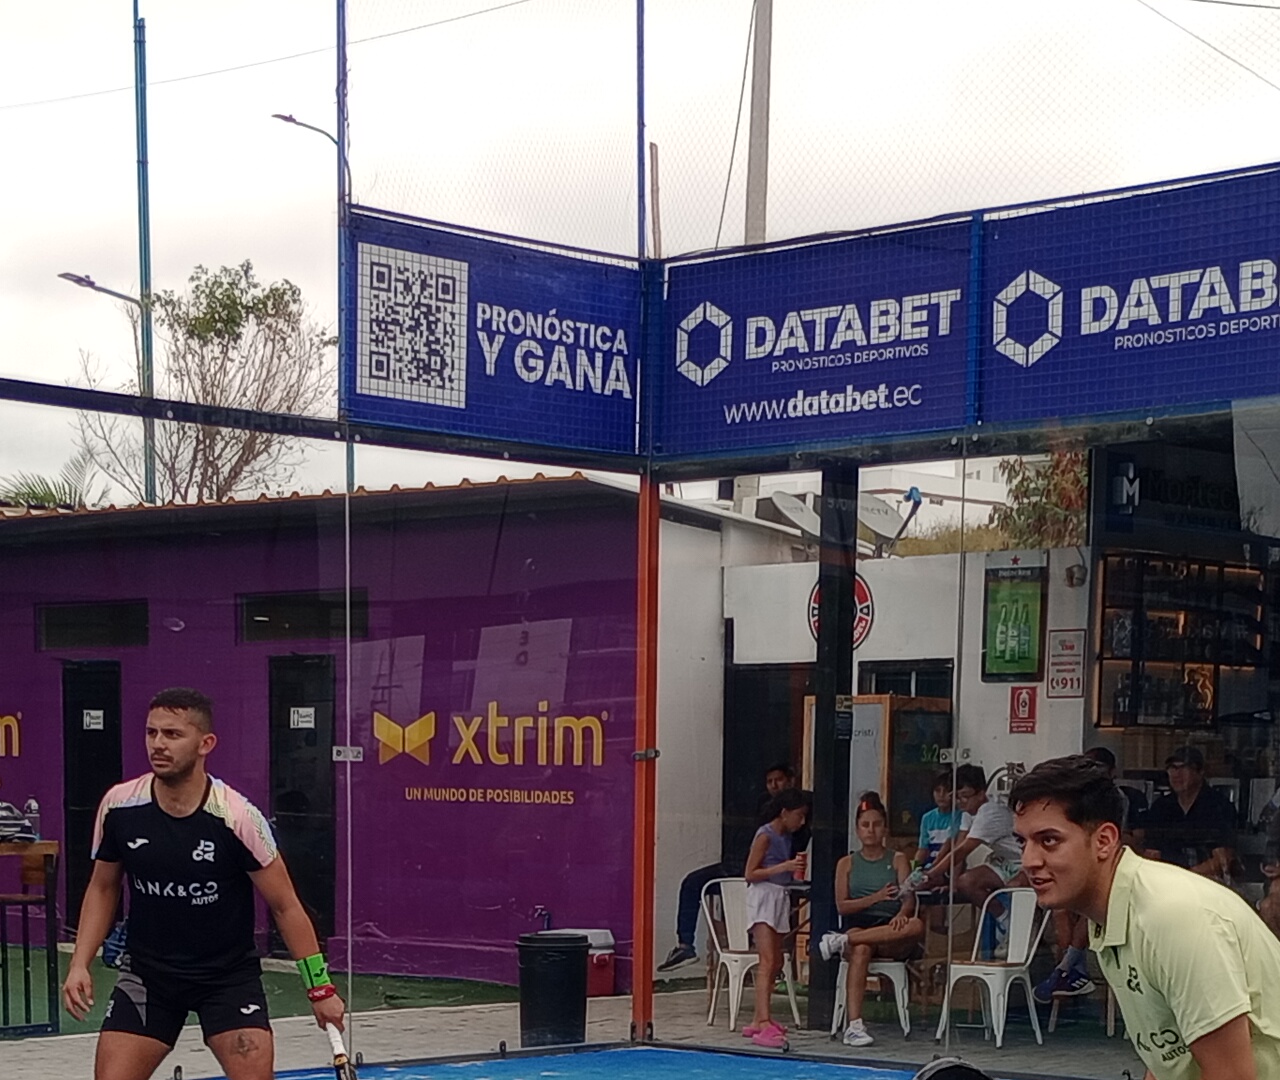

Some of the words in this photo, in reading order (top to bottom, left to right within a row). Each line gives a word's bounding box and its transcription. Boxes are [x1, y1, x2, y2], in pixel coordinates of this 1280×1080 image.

[476, 302, 629, 355] PRONÓSTICA
[745, 288, 960, 361] DATABET
[1114, 322, 1216, 351] PRONOSTICOS
[477, 332, 506, 377] Y
[513, 338, 632, 400] GANA
[771, 353, 852, 374] PRONOSTICOS
[853, 343, 929, 365] DEPORTIVOS
[723, 381, 922, 426] www.databet.ec
[1060, 676, 1081, 690] 911
[451, 700, 603, 767] xtrim
[405, 787, 422, 801] UN
[423, 787, 468, 802] MUNDO
[469, 788, 485, 802] DE
[486, 788, 575, 804] POSIBILIDADES
[1161, 1045, 1191, 1062] AUTO
